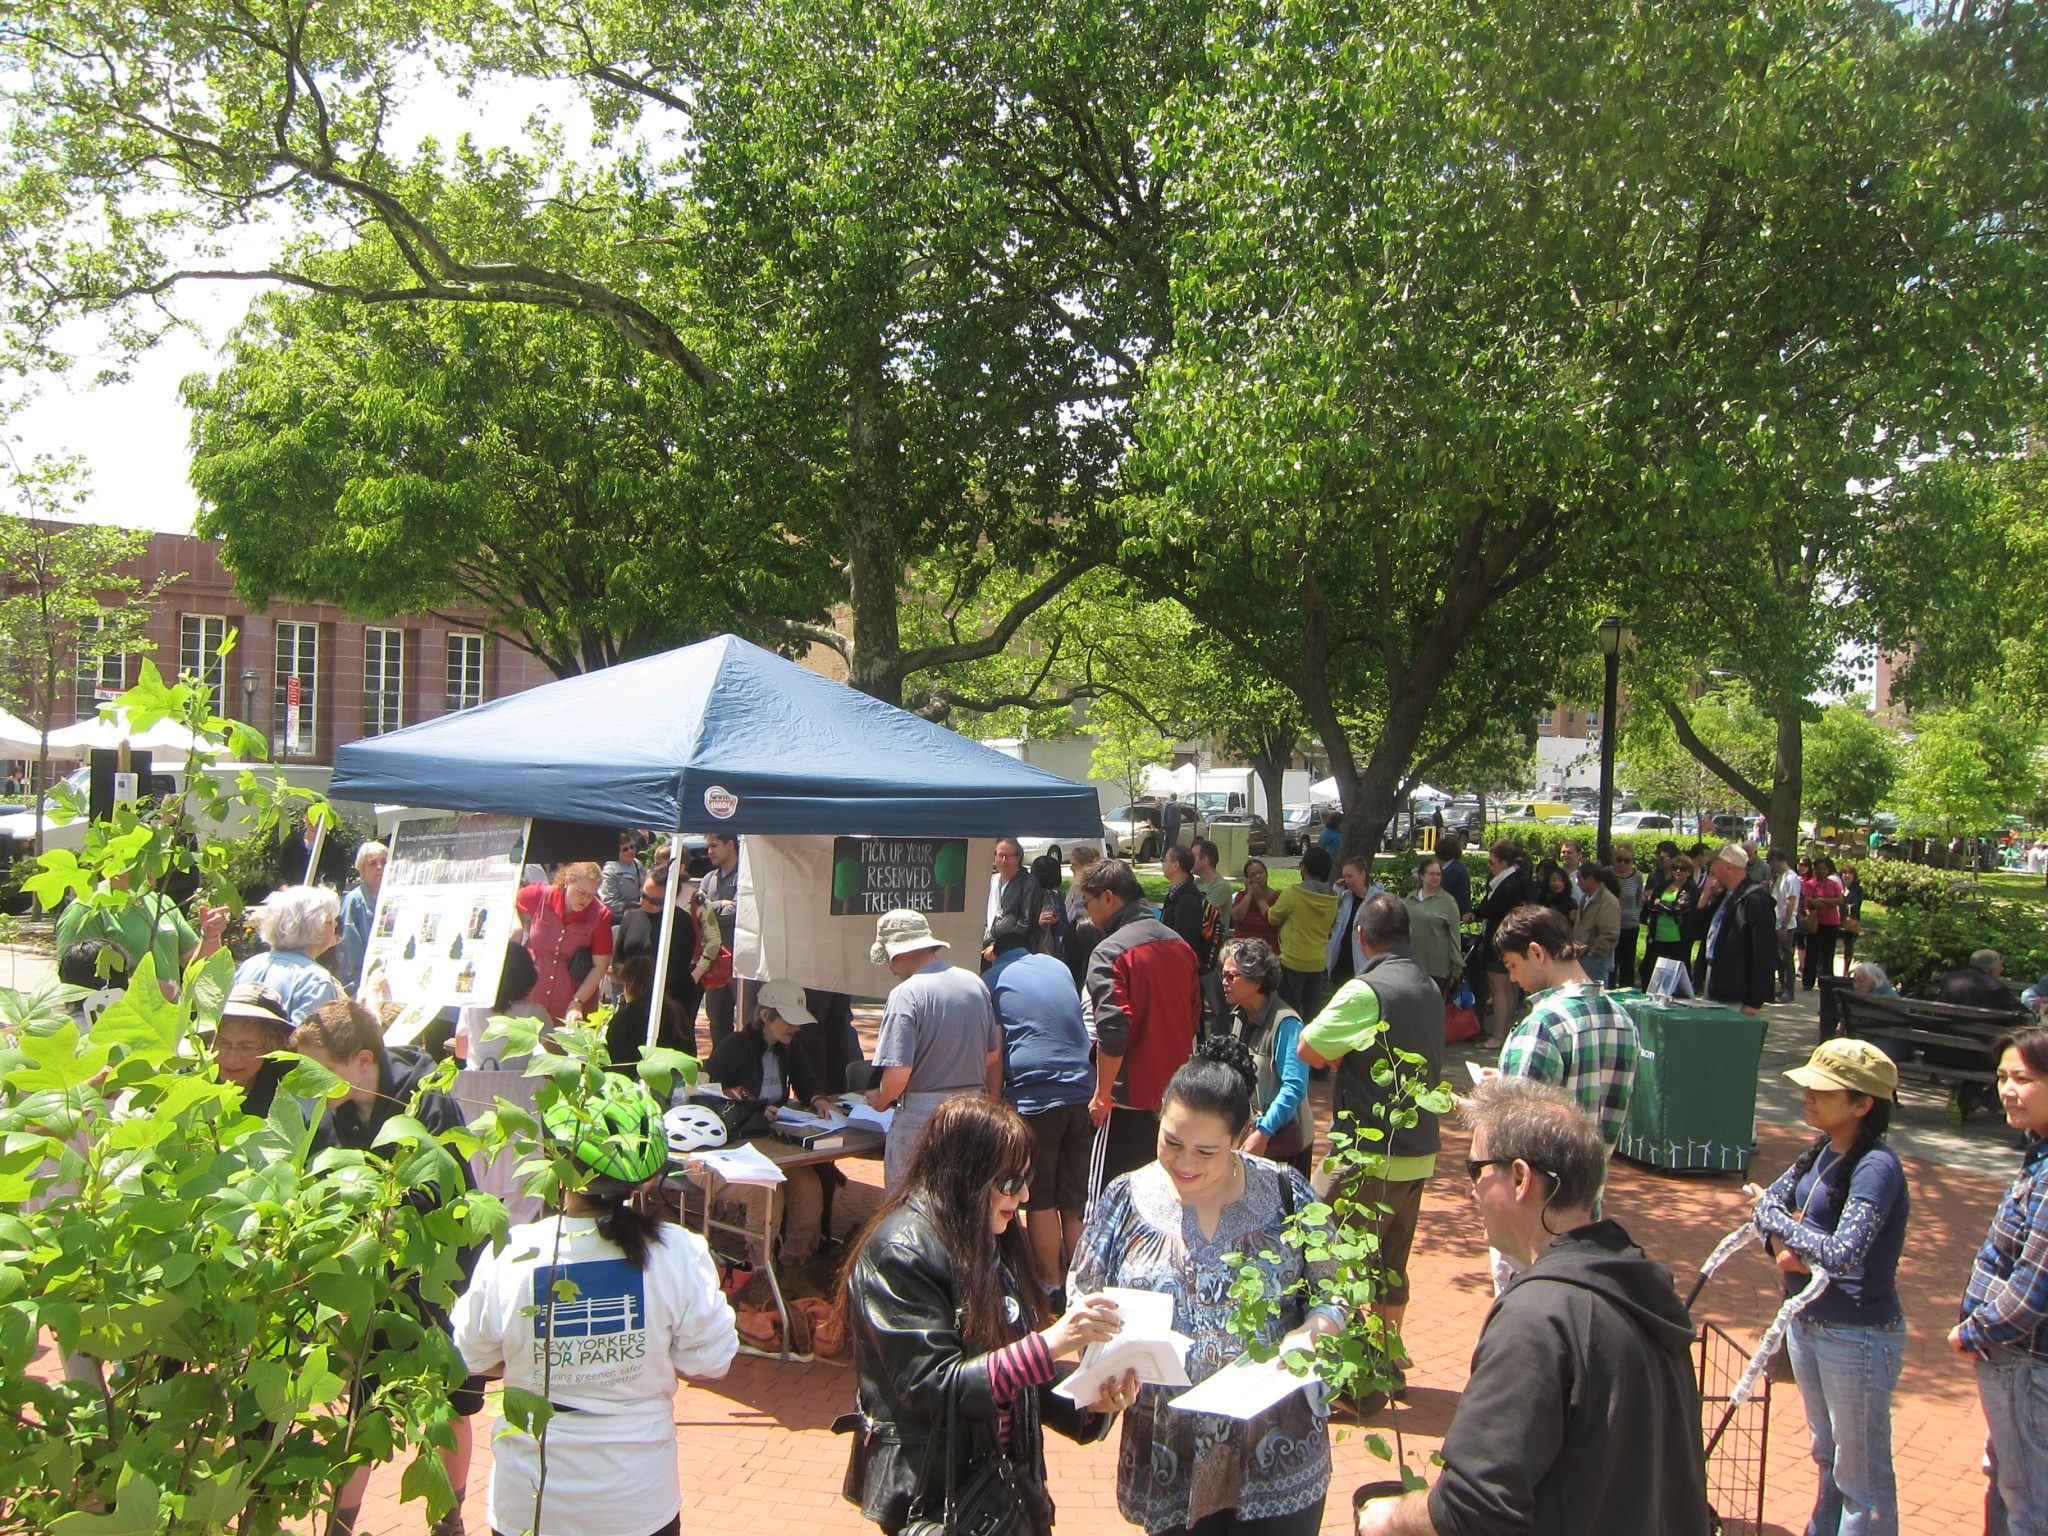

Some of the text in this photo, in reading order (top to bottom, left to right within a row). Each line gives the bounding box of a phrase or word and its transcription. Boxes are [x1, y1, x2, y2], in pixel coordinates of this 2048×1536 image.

[861, 842, 933, 863] PICK UP YOUR
[867, 865, 931, 889] RESERVED
[861, 891, 934, 913] TREES HERE
[534, 1331, 646, 1353] NEW YORKERS
[534, 1343, 646, 1368] FOR PARKS
